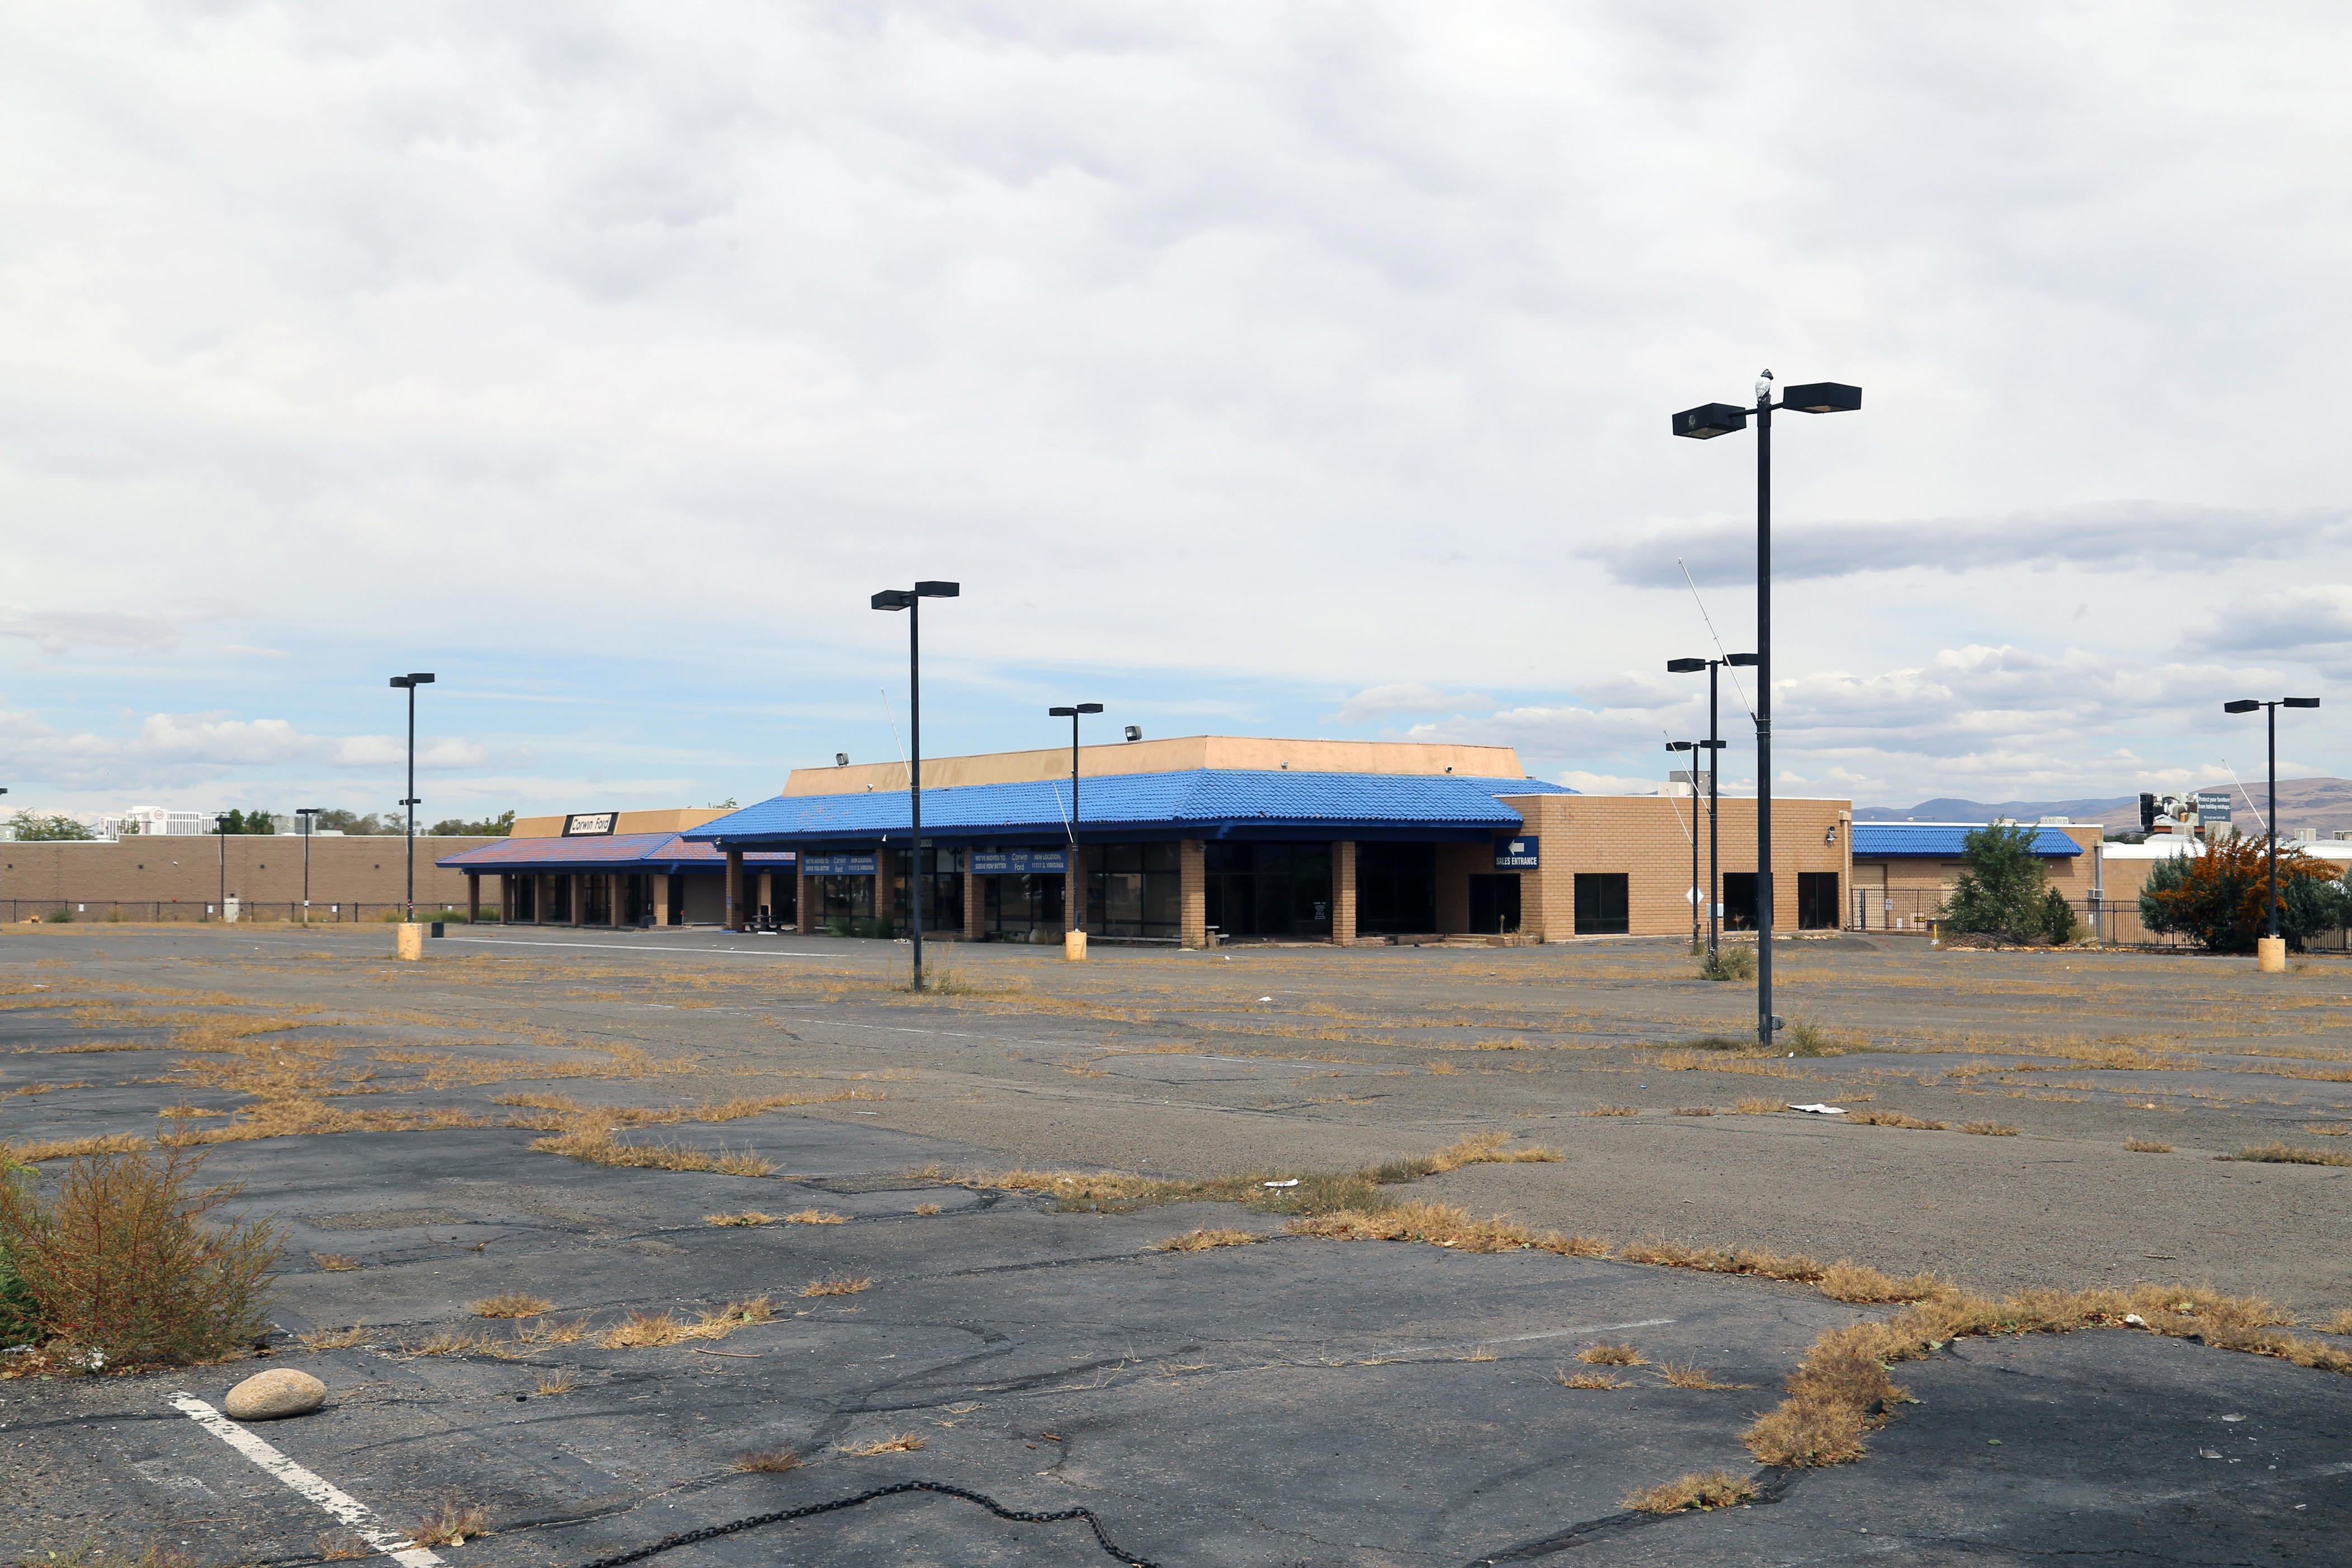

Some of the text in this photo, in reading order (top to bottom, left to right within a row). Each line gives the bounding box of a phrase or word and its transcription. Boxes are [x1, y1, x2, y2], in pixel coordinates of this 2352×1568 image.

[572, 817, 610, 830] Corwin Ford
[1496, 857, 1537, 865] SALES ENTRANCE
